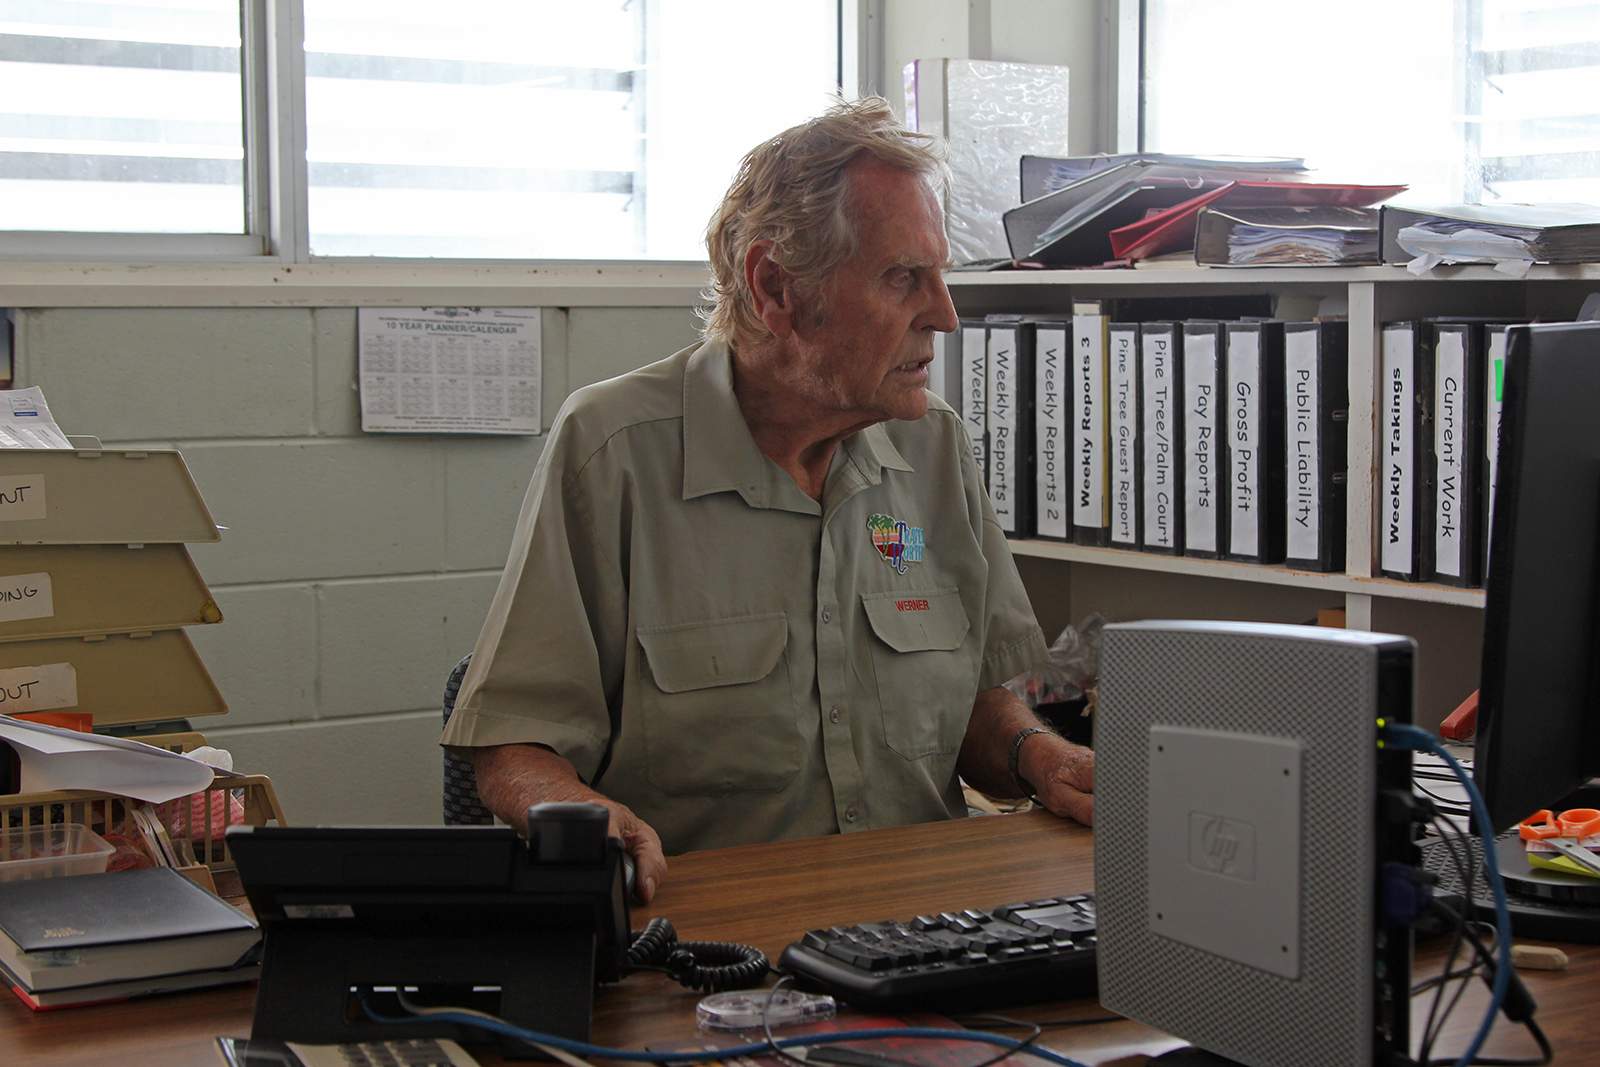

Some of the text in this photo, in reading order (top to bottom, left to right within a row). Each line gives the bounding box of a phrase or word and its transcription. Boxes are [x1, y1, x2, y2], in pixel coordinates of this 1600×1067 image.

[386, 321, 397, 330] 10
[399, 322, 423, 331] YEAR
[969, 357, 986, 426] Weekly
[993, 349, 1010, 516] Weekly Reports 1
[1042, 348, 1059, 521] Weekly Reports 2
[1080, 336, 1093, 508] Weekly Reports 3
[1116, 338, 1130, 538] Pine Tree Guest Report
[1153, 339, 1170, 545] Pine Tree/Palm Court
[1193, 384, 1212, 508] Pay Reports
[1236, 381, 1252, 512] Gross Profit
[1295, 369, 1313, 528] Public Liability
[1389, 366, 1403, 544] Weekly Takings
[1441, 376, 1458, 538] Current Work
[895, 599, 929, 612] WERNER
